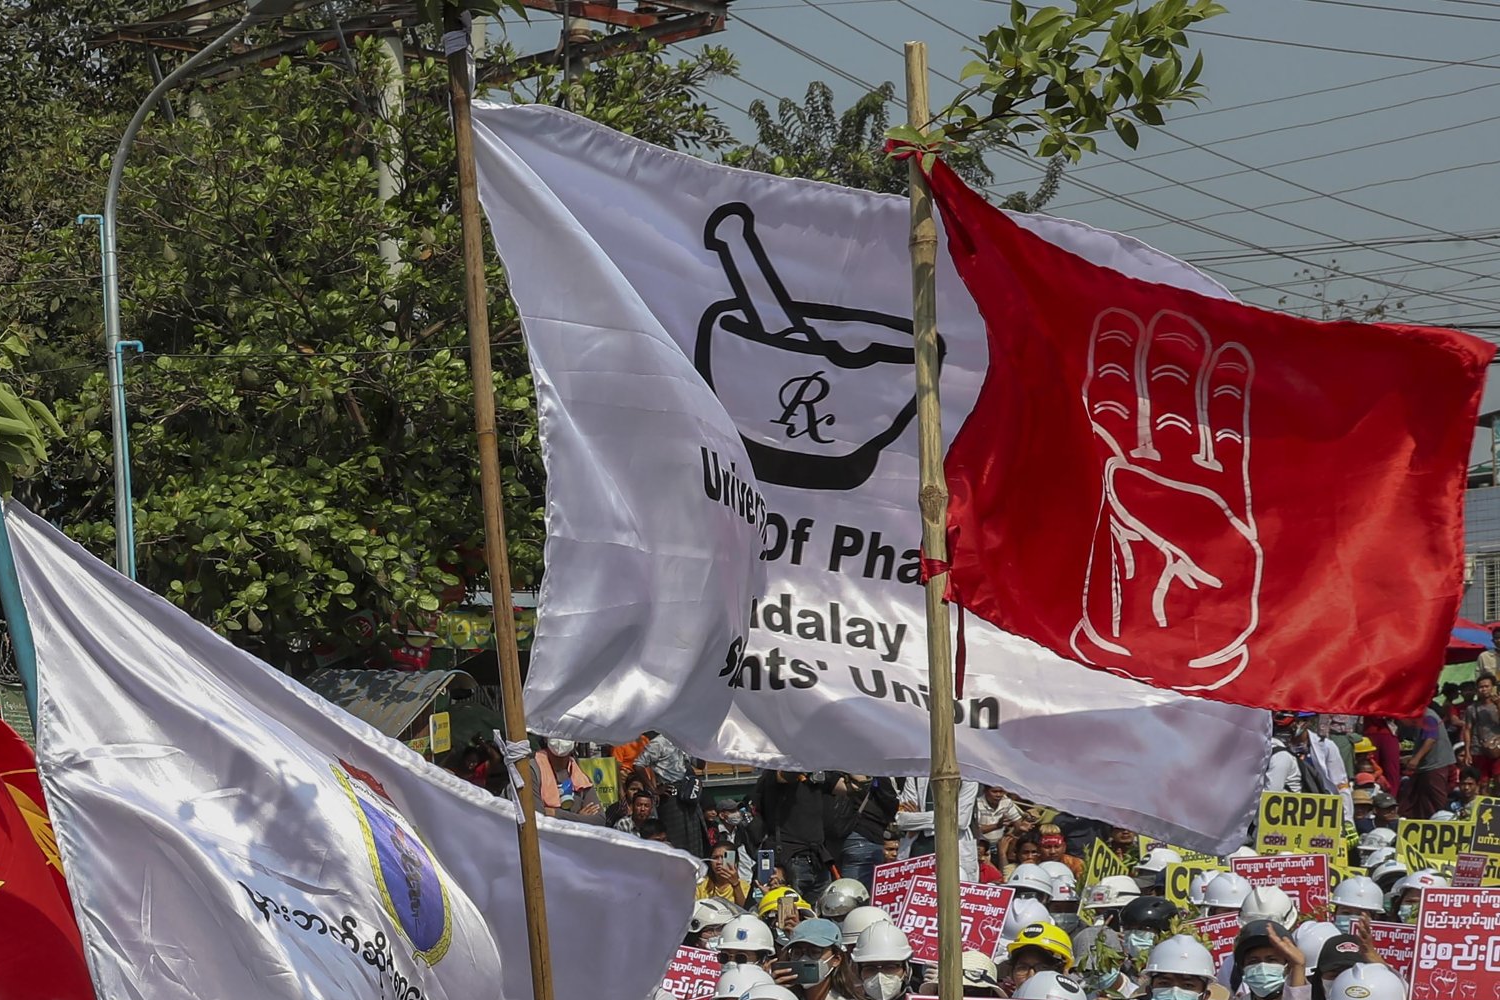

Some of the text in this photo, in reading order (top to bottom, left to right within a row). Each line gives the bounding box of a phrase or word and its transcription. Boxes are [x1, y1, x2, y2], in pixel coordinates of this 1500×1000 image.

[760, 513, 814, 566] Of
[1264, 795, 1339, 829] CRPH
[1403, 822, 1476, 855] CRPH
